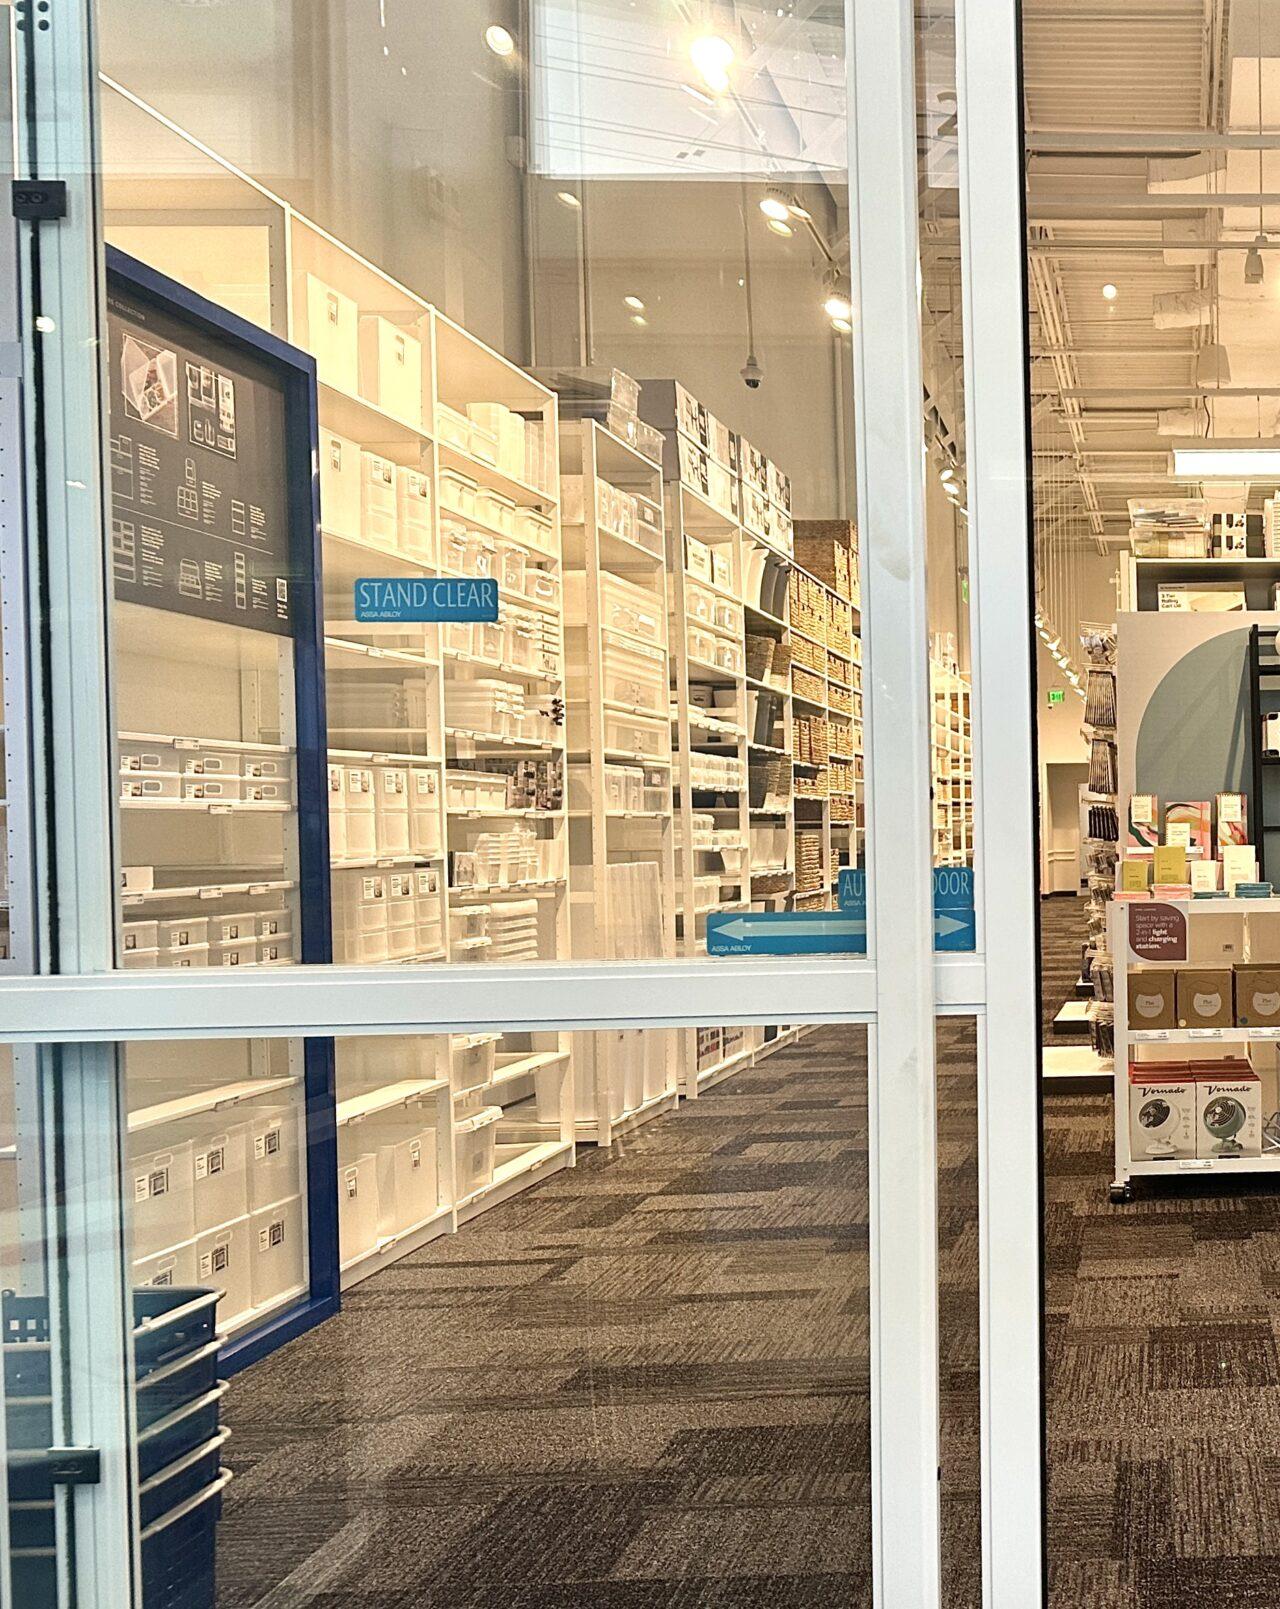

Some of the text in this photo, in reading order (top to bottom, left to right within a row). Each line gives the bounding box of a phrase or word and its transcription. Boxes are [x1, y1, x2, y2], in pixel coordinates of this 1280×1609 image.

[360, 582, 494, 607] STAND CLEAR
[1138, 1087, 1186, 1097] Vornado
[1203, 1085, 1252, 1095] Vornado
